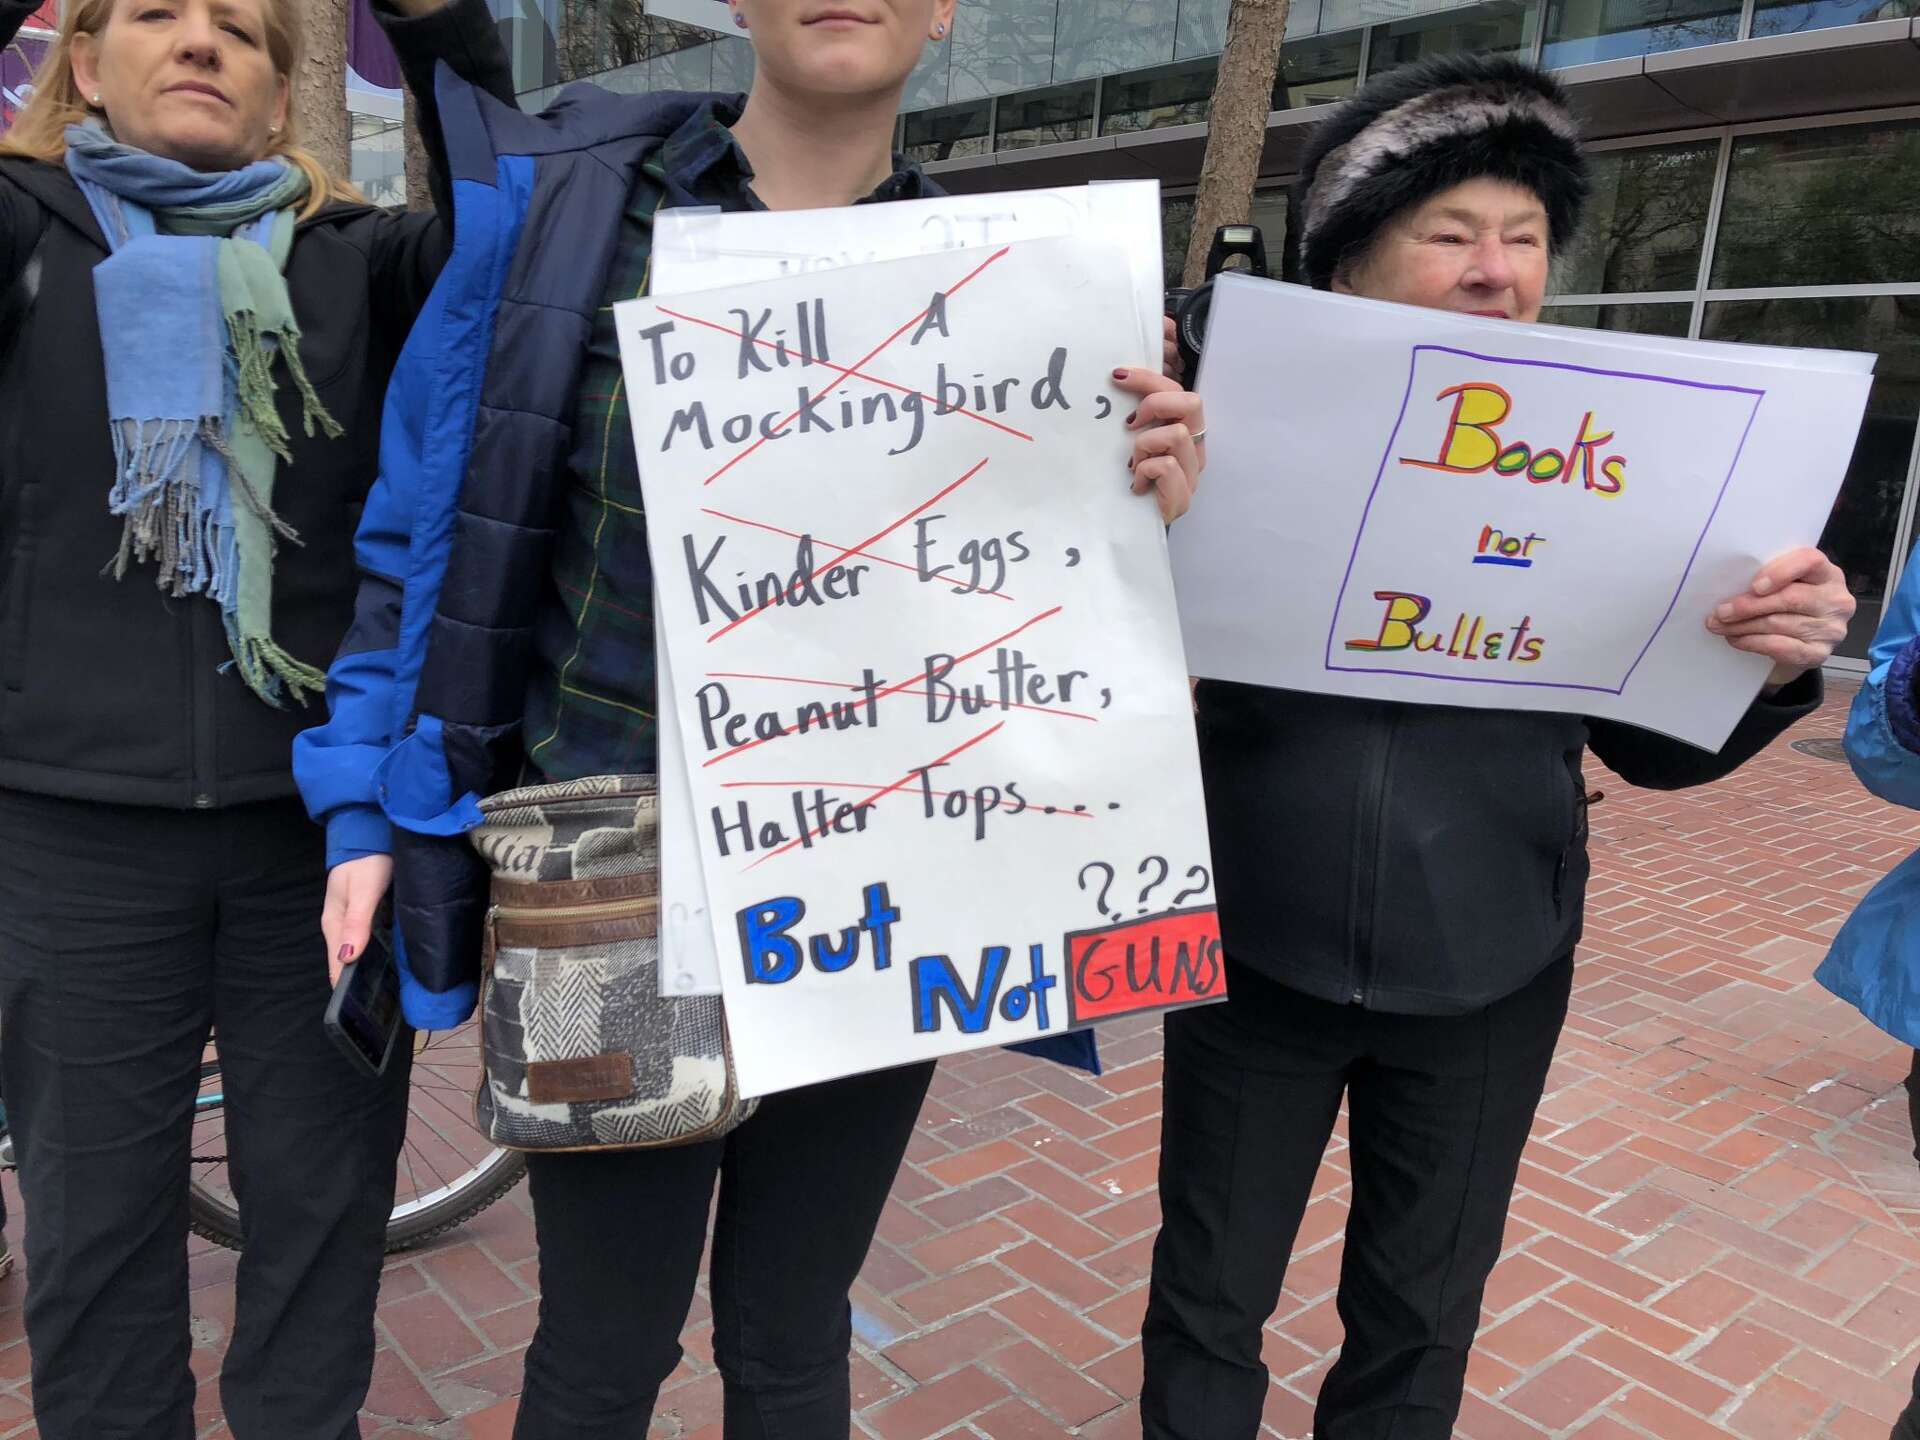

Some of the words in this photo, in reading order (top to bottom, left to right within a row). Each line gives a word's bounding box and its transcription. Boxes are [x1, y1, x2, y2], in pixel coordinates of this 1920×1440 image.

[640, 320, 696, 385] To
[728, 298, 831, 379] Kill
[910, 291, 951, 345] A
[1398, 382, 1627, 497] Books
[683, 534, 870, 625] Kinder
[1477, 524, 1548, 558] not
[1344, 591, 1545, 662] Bullets
[695, 669, 887, 751] Peanut
[924, 647, 1113, 722] Butter,
[711, 788, 877, 857] Halter
[736, 881, 901, 985] But
[908, 943, 1057, 1034] Not
[1076, 934, 1222, 1001] GUNS
